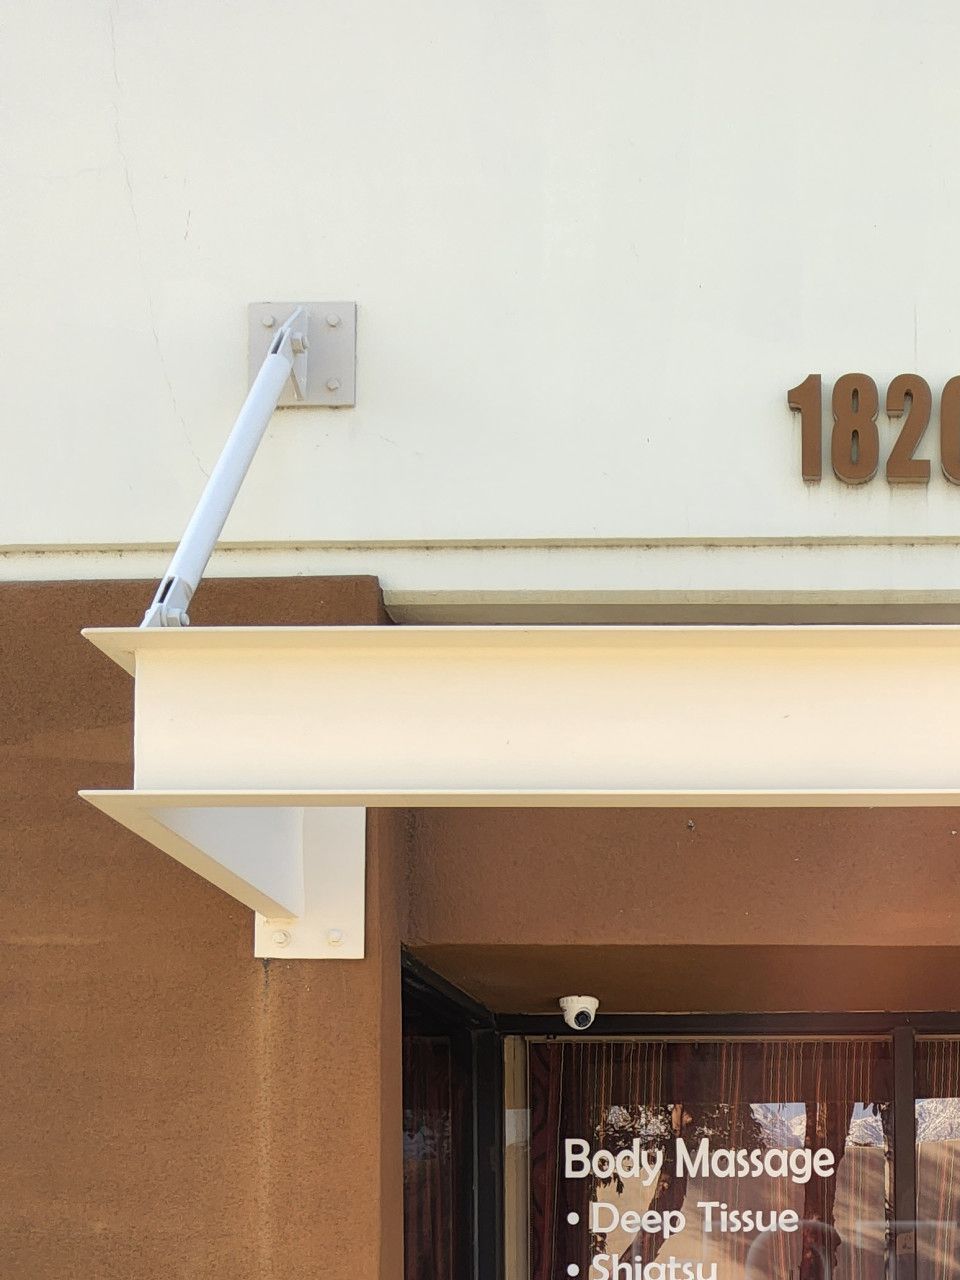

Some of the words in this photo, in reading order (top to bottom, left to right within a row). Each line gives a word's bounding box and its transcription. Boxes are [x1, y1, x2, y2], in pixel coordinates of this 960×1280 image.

[564, 1137, 664, 1186] Body
[676, 1138, 835, 1184] Massage
[590, 1201, 686, 1239] Deep
[697, 1201, 799, 1234] Tissue
